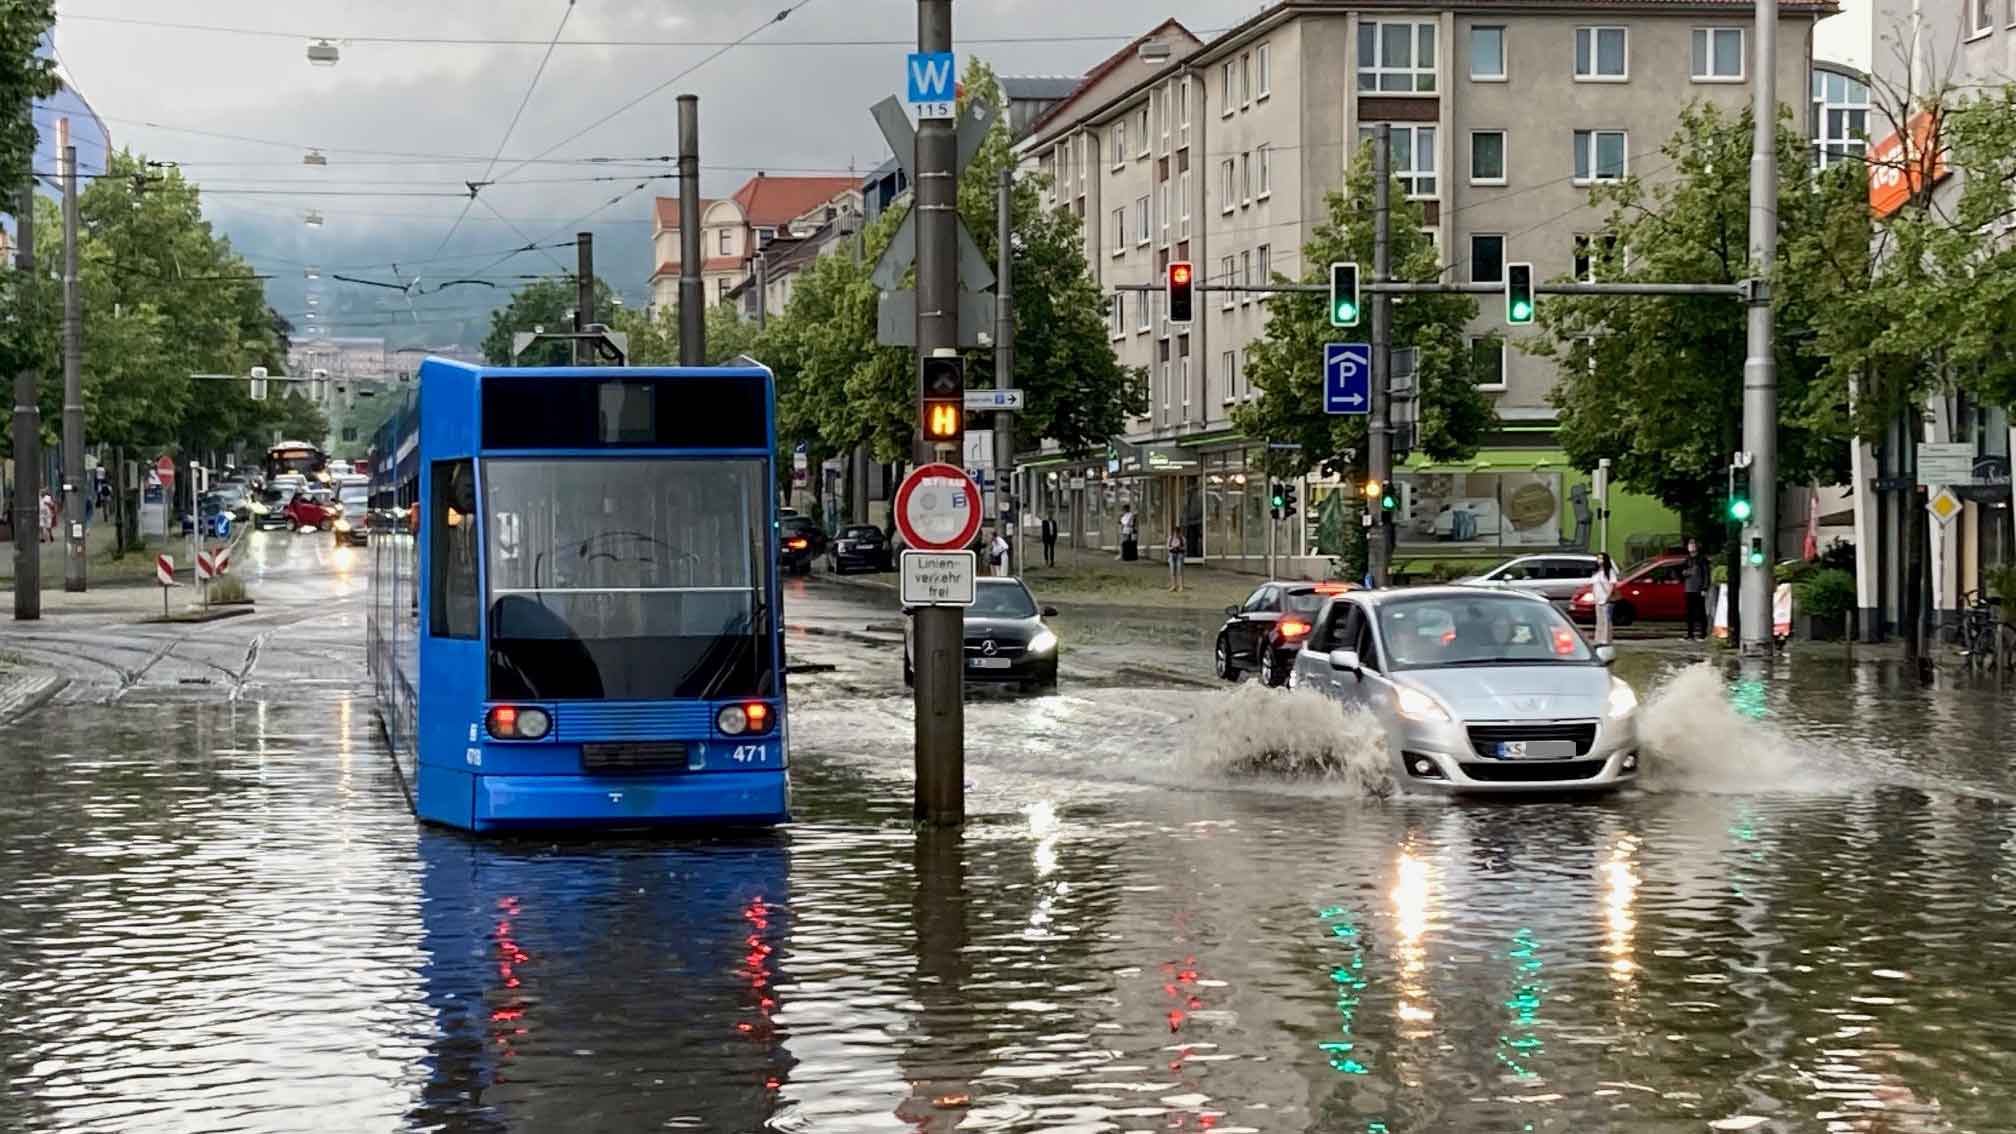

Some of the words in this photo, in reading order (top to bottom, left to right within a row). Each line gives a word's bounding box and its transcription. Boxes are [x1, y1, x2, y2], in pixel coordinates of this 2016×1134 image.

[911, 60, 950, 95] W
[916, 104, 948, 116] 115
[1339, 361, 1358, 388] P
[932, 405, 956, 435] H
[918, 558, 960, 569] Linien-
[914, 572, 961, 583] verkehr
[928, 586, 949, 598] frei
[733, 746, 766, 762] 471
